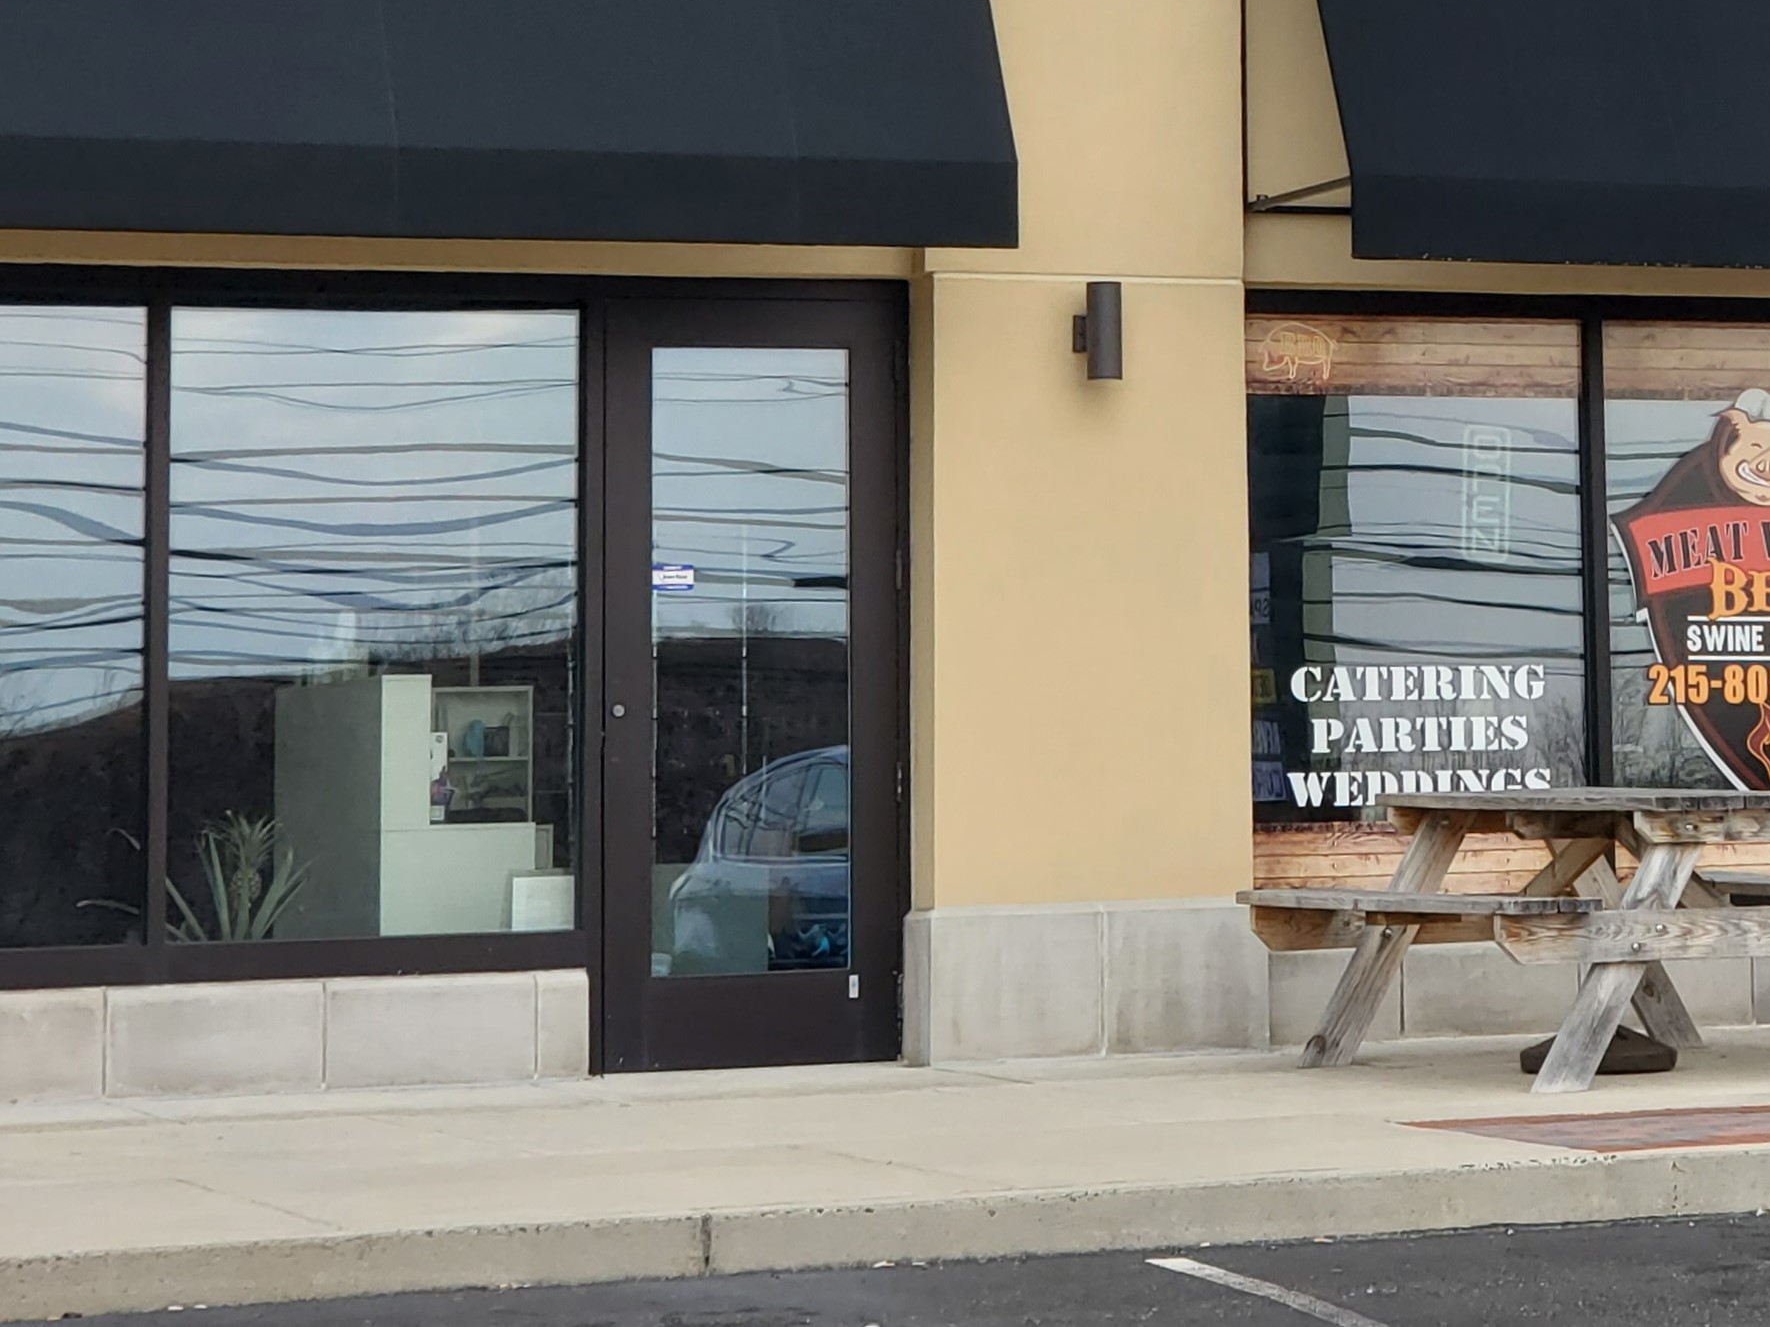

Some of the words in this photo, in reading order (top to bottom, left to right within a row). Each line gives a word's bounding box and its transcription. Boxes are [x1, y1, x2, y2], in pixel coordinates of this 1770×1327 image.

[1647, 521, 1748, 580] MEAT
[1686, 624, 1765, 653] SWINE
[1290, 664, 1546, 702] CATERING
[1310, 715, 1529, 753] PARTIES
